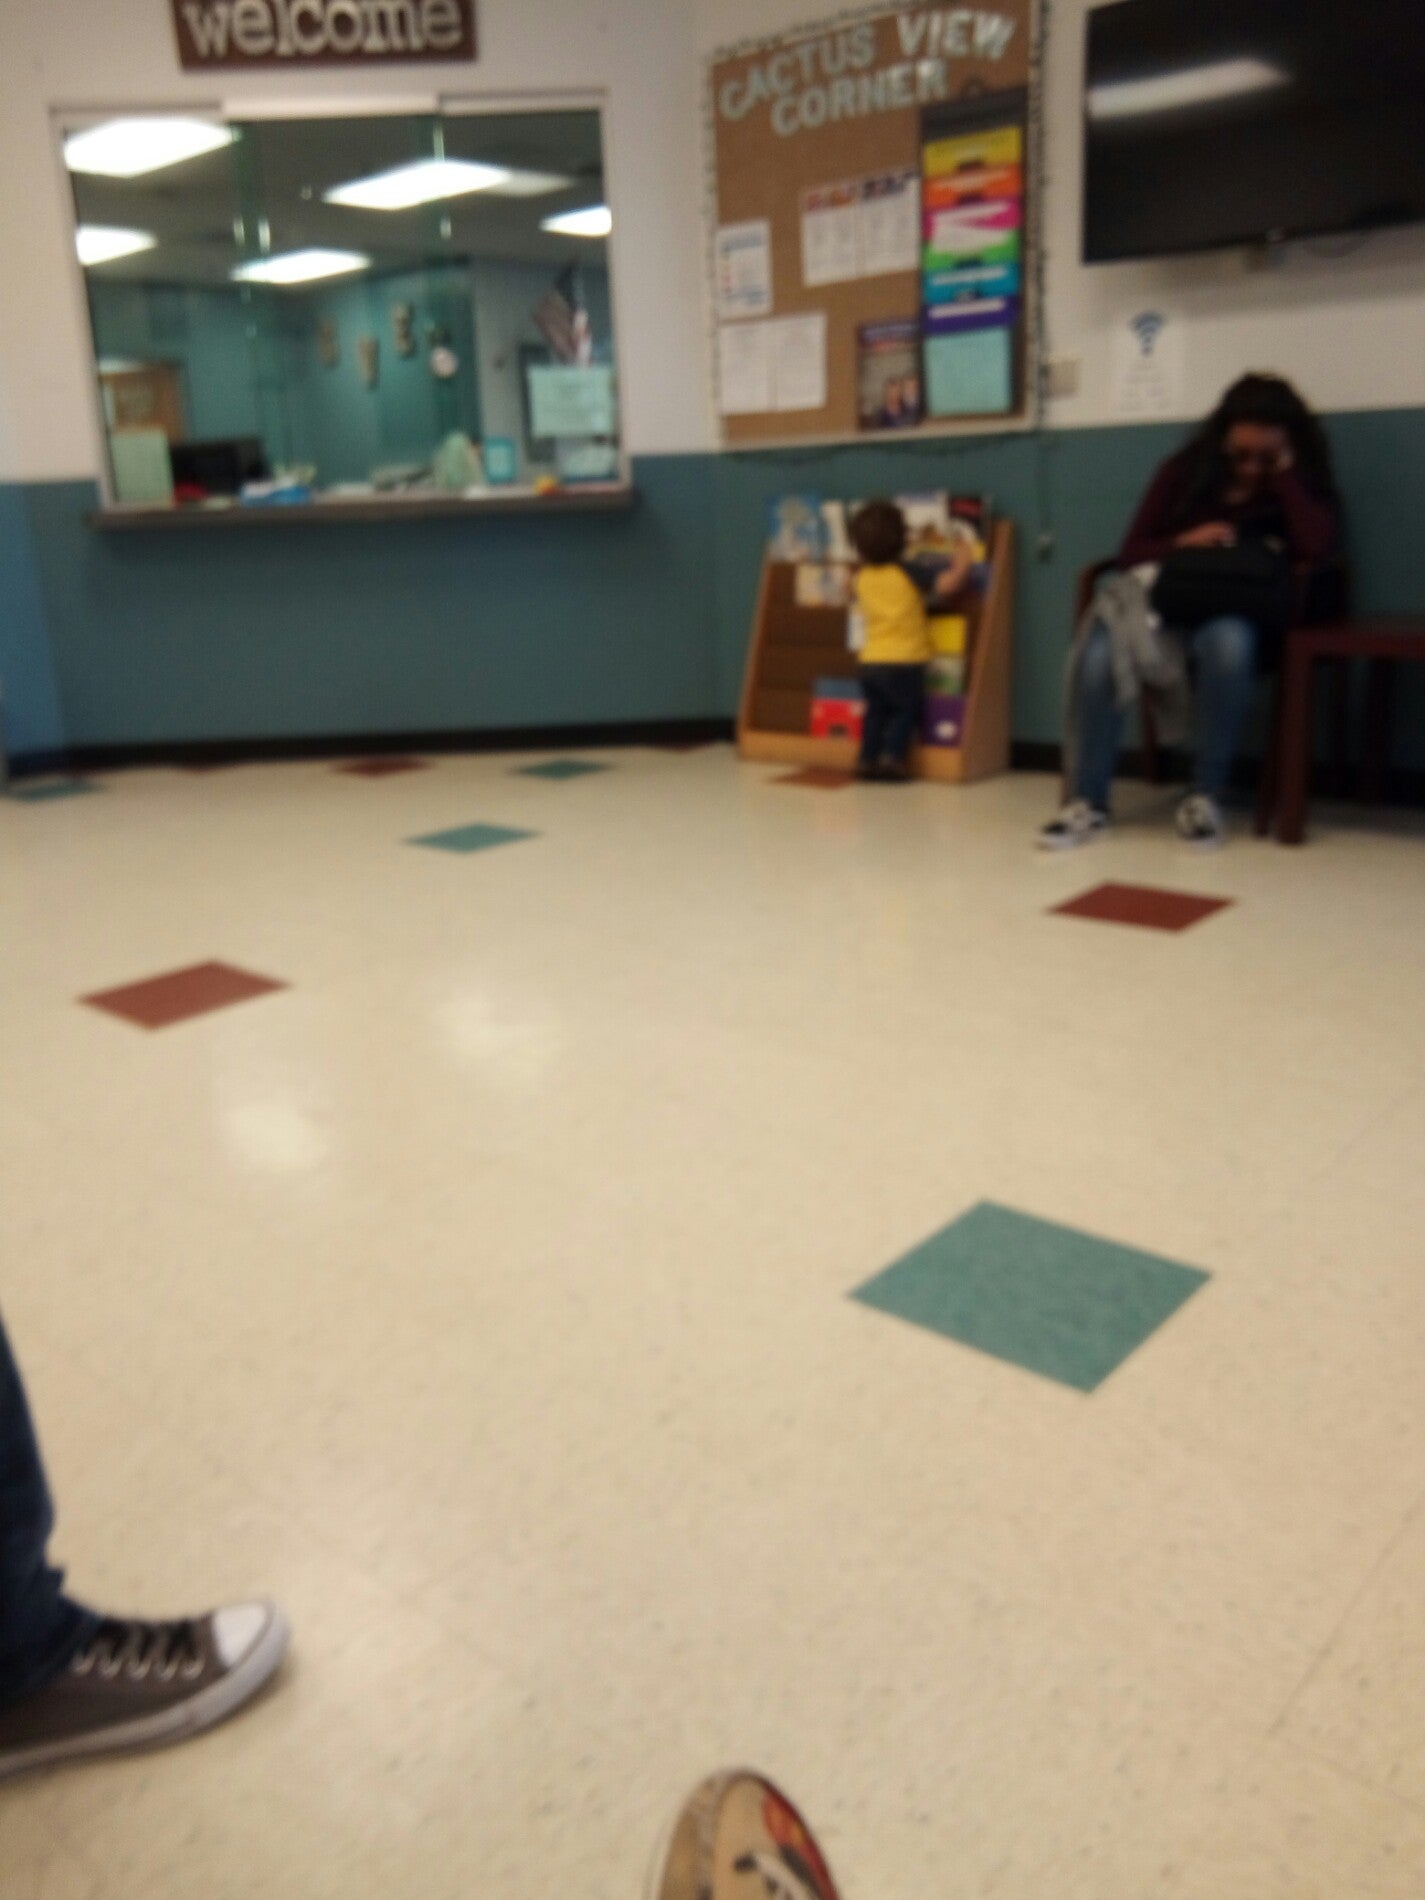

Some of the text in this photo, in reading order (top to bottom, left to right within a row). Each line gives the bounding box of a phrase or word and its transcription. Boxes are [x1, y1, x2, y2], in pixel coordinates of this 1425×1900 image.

[182, 0, 463, 57] welcome
[719, 9, 1016, 121] CACTUS VIEW
[770, 57, 948, 137] CORNER
